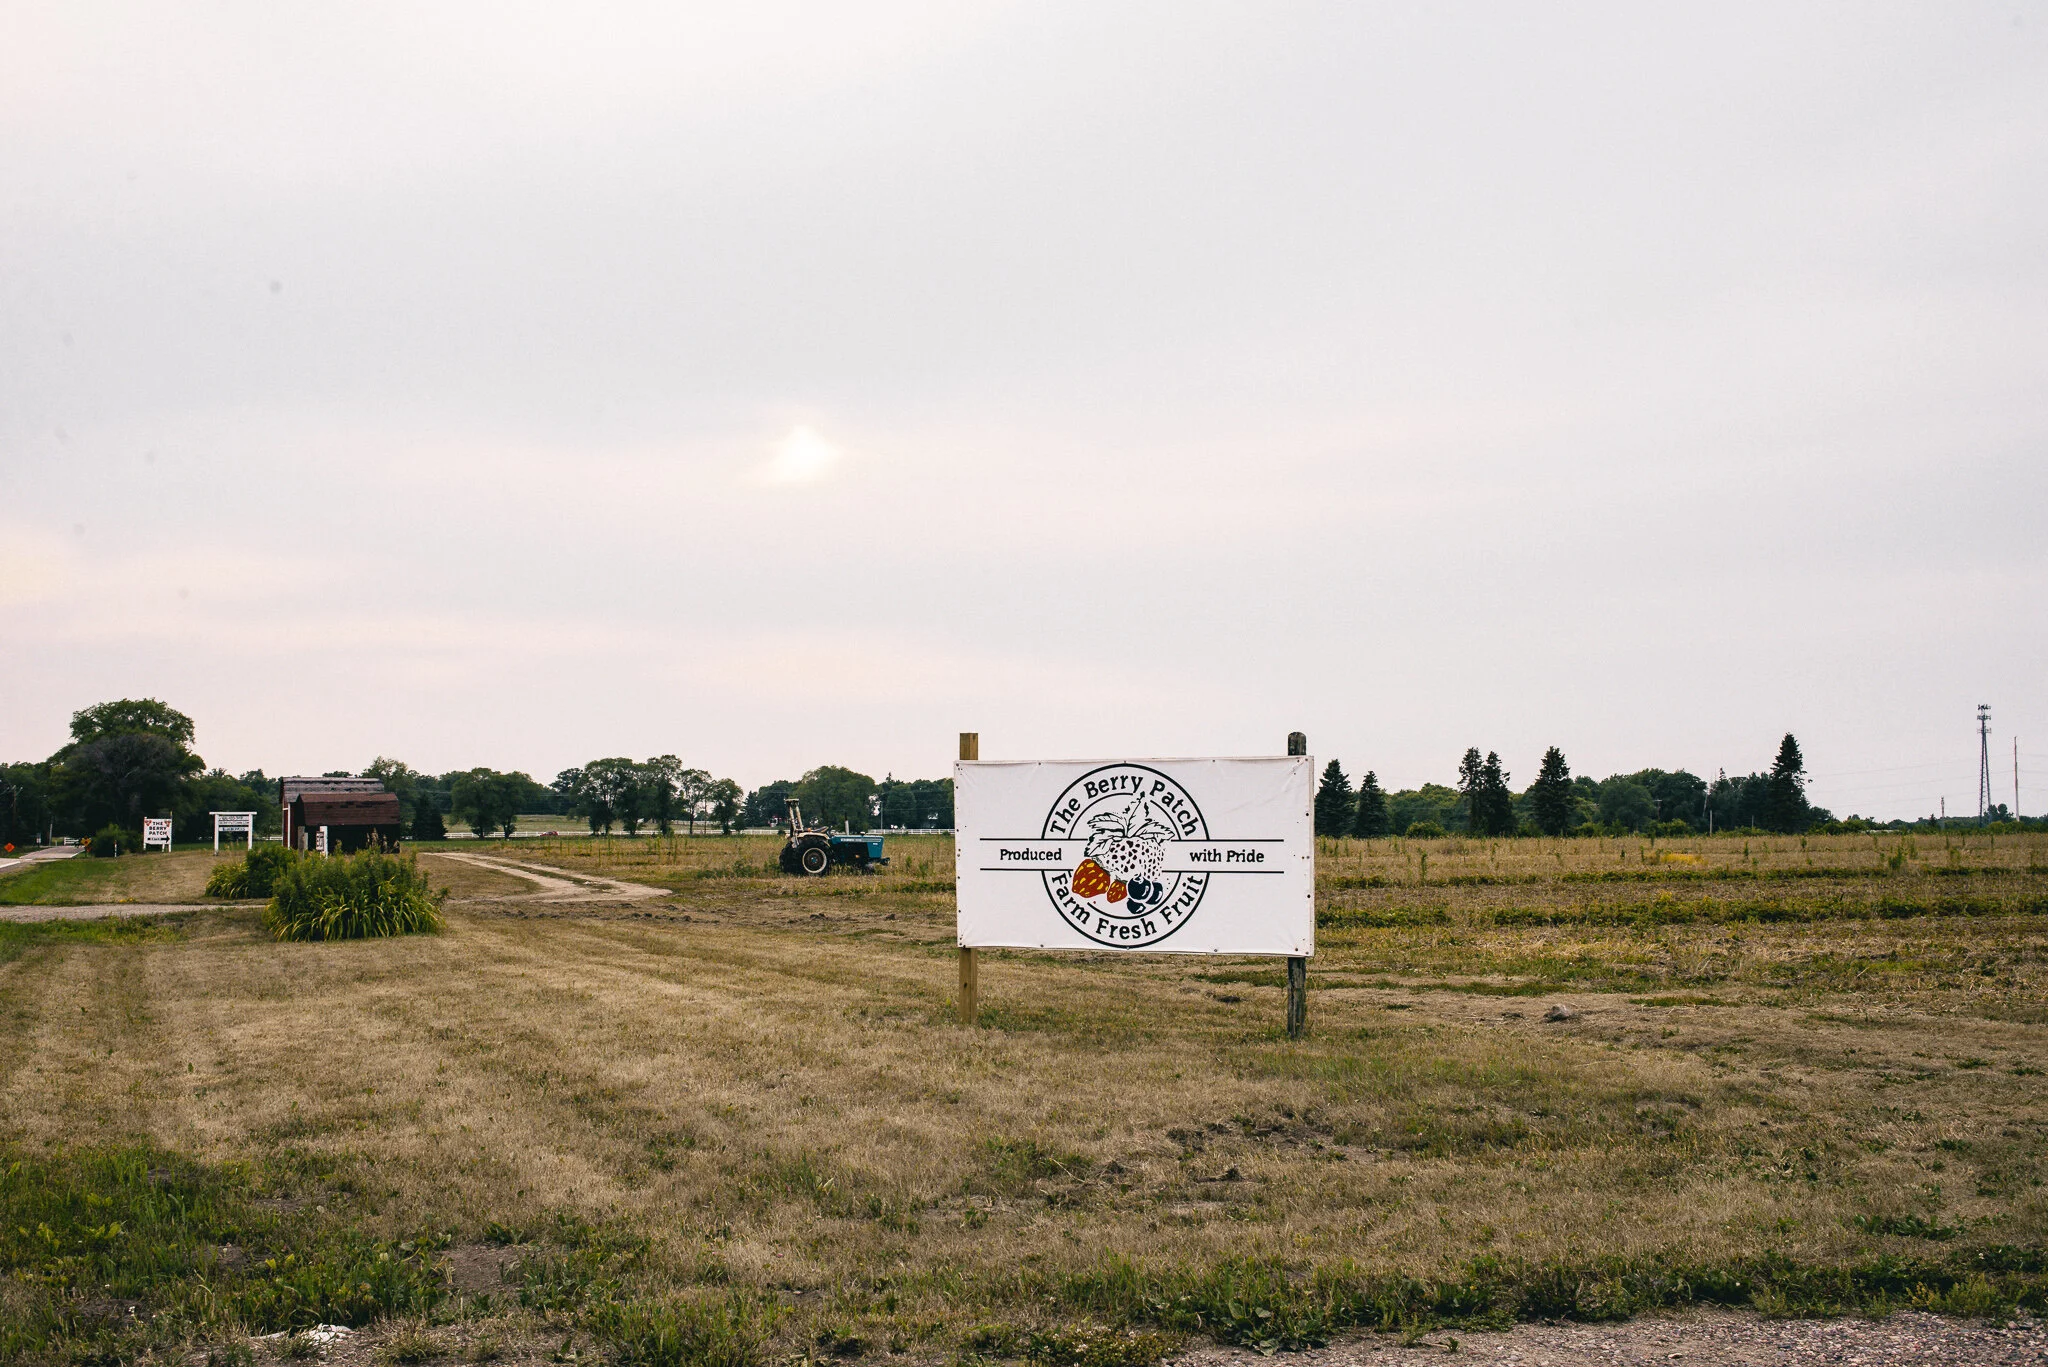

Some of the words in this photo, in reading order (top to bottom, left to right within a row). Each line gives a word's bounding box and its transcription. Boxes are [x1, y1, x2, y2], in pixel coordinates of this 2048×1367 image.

[1050, 797, 1080, 834] The
[1084, 775, 1143, 799] Berry
[1150, 780, 1199, 836] Patch
[1000, 849, 1062, 861] Produced
[1189, 850, 1222, 862] with
[1226, 850, 1265, 863] Pride
[1052, 871, 1092, 924] Farm
[1096, 917, 1157, 939] Fresh
[1159, 875, 1203, 925] Fruit
